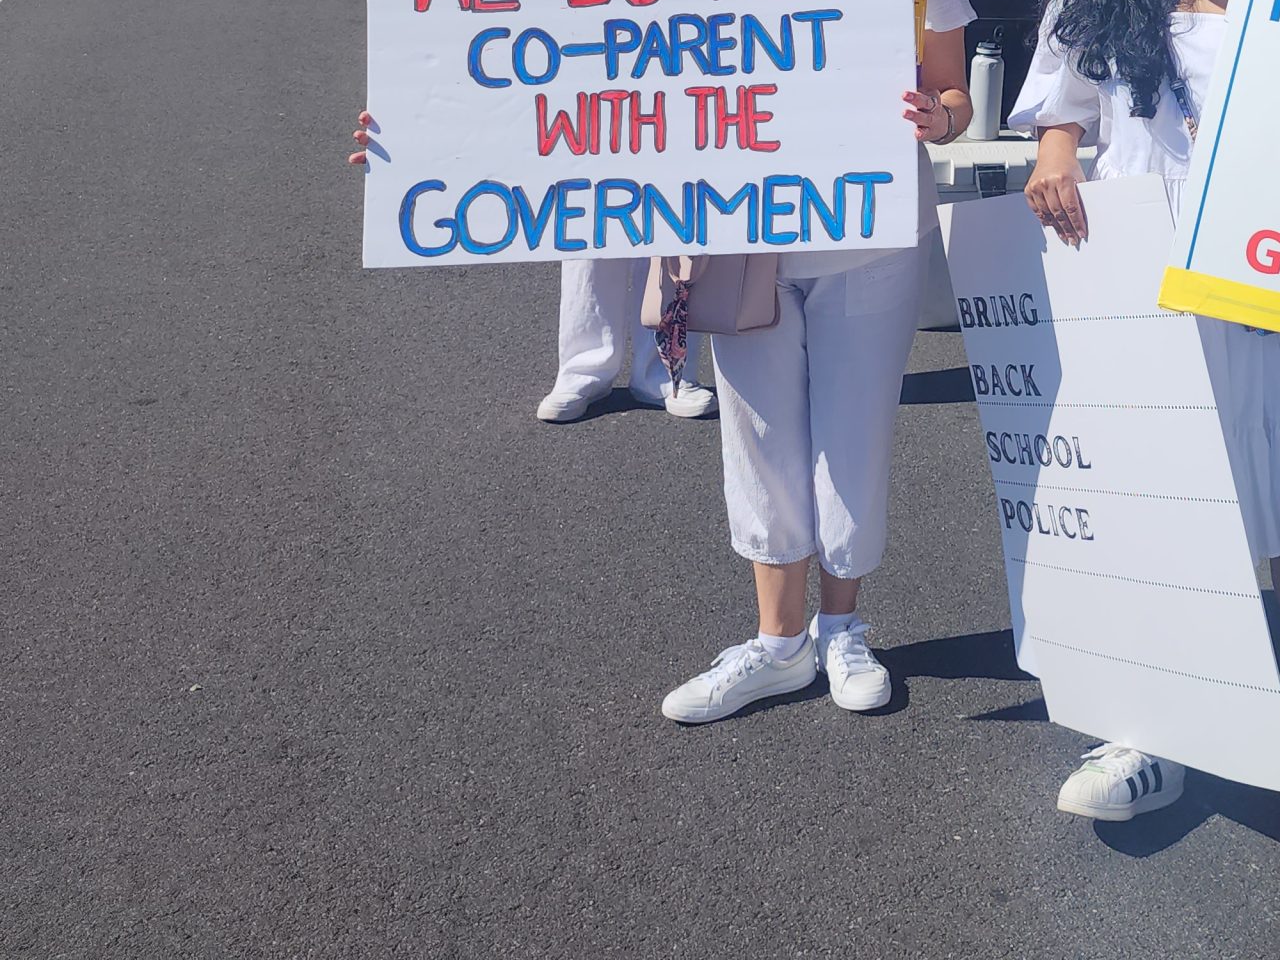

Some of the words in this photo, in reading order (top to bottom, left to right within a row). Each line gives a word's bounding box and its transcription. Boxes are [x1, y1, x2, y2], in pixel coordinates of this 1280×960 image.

[467, 9, 843, 88] CO-PARENT
[534, 89, 666, 157] WITH
[685, 83, 782, 153] THE
[399, 171, 894, 257] GOVERNMENT
[957, 293, 1040, 329] BRING
[971, 363, 1042, 397] BACK
[985, 430, 1092, 470] SCHOOL
[1000, 498, 1095, 541] POLICE
